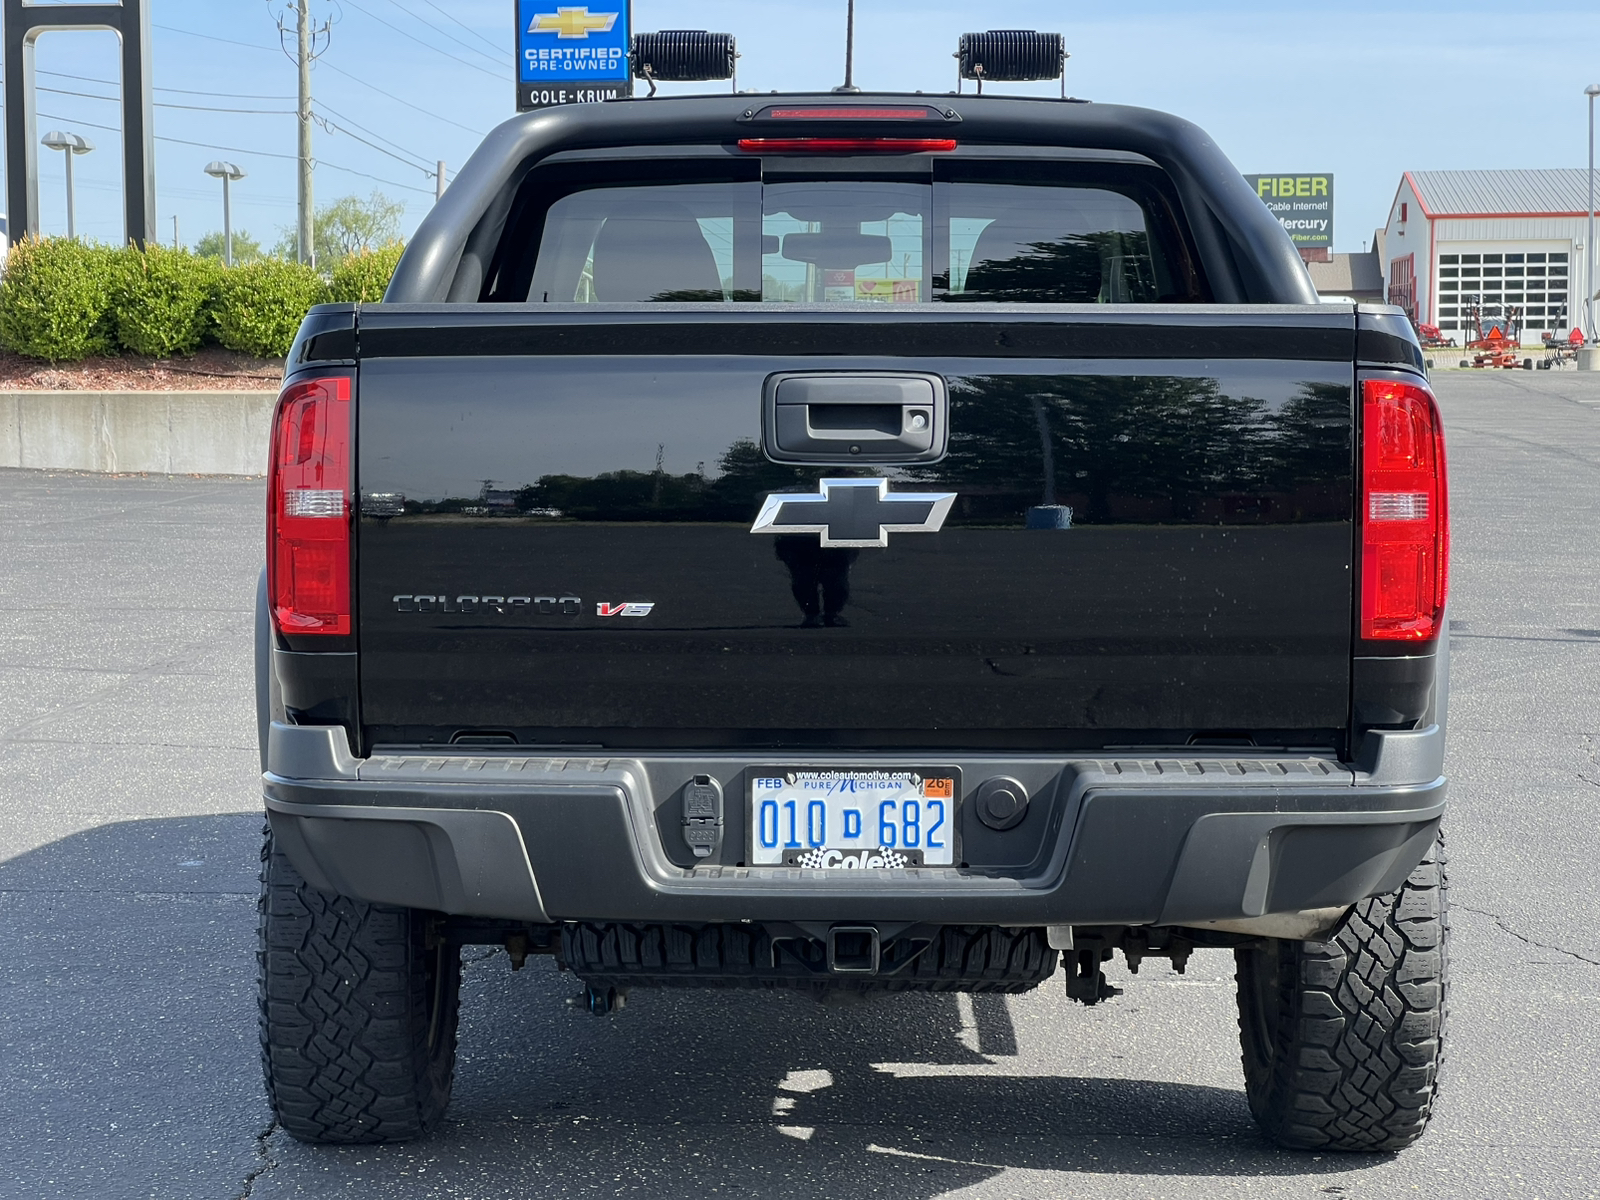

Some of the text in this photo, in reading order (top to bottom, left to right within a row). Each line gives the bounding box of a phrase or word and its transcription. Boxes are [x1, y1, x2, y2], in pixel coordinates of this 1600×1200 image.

[524, 47, 622, 60] CERTIFIED
[529, 59, 618, 71] PRE-OWNED
[530, 89, 617, 104] COLE-KRUM
[1257, 176, 1328, 197] FIBER
[1266, 201, 1328, 211] Cable Internet!
[393, 594, 655, 616] COLORADO V6
[796, 770, 911, 780] www.coleautomotive.com
[757, 778, 782, 789] FEB
[804, 779, 902, 796] PURE MICHIGAN
[927, 779, 945, 789] 26
[760, 800, 945, 848] 010 D 682
[821, 849, 885, 869] Cole
